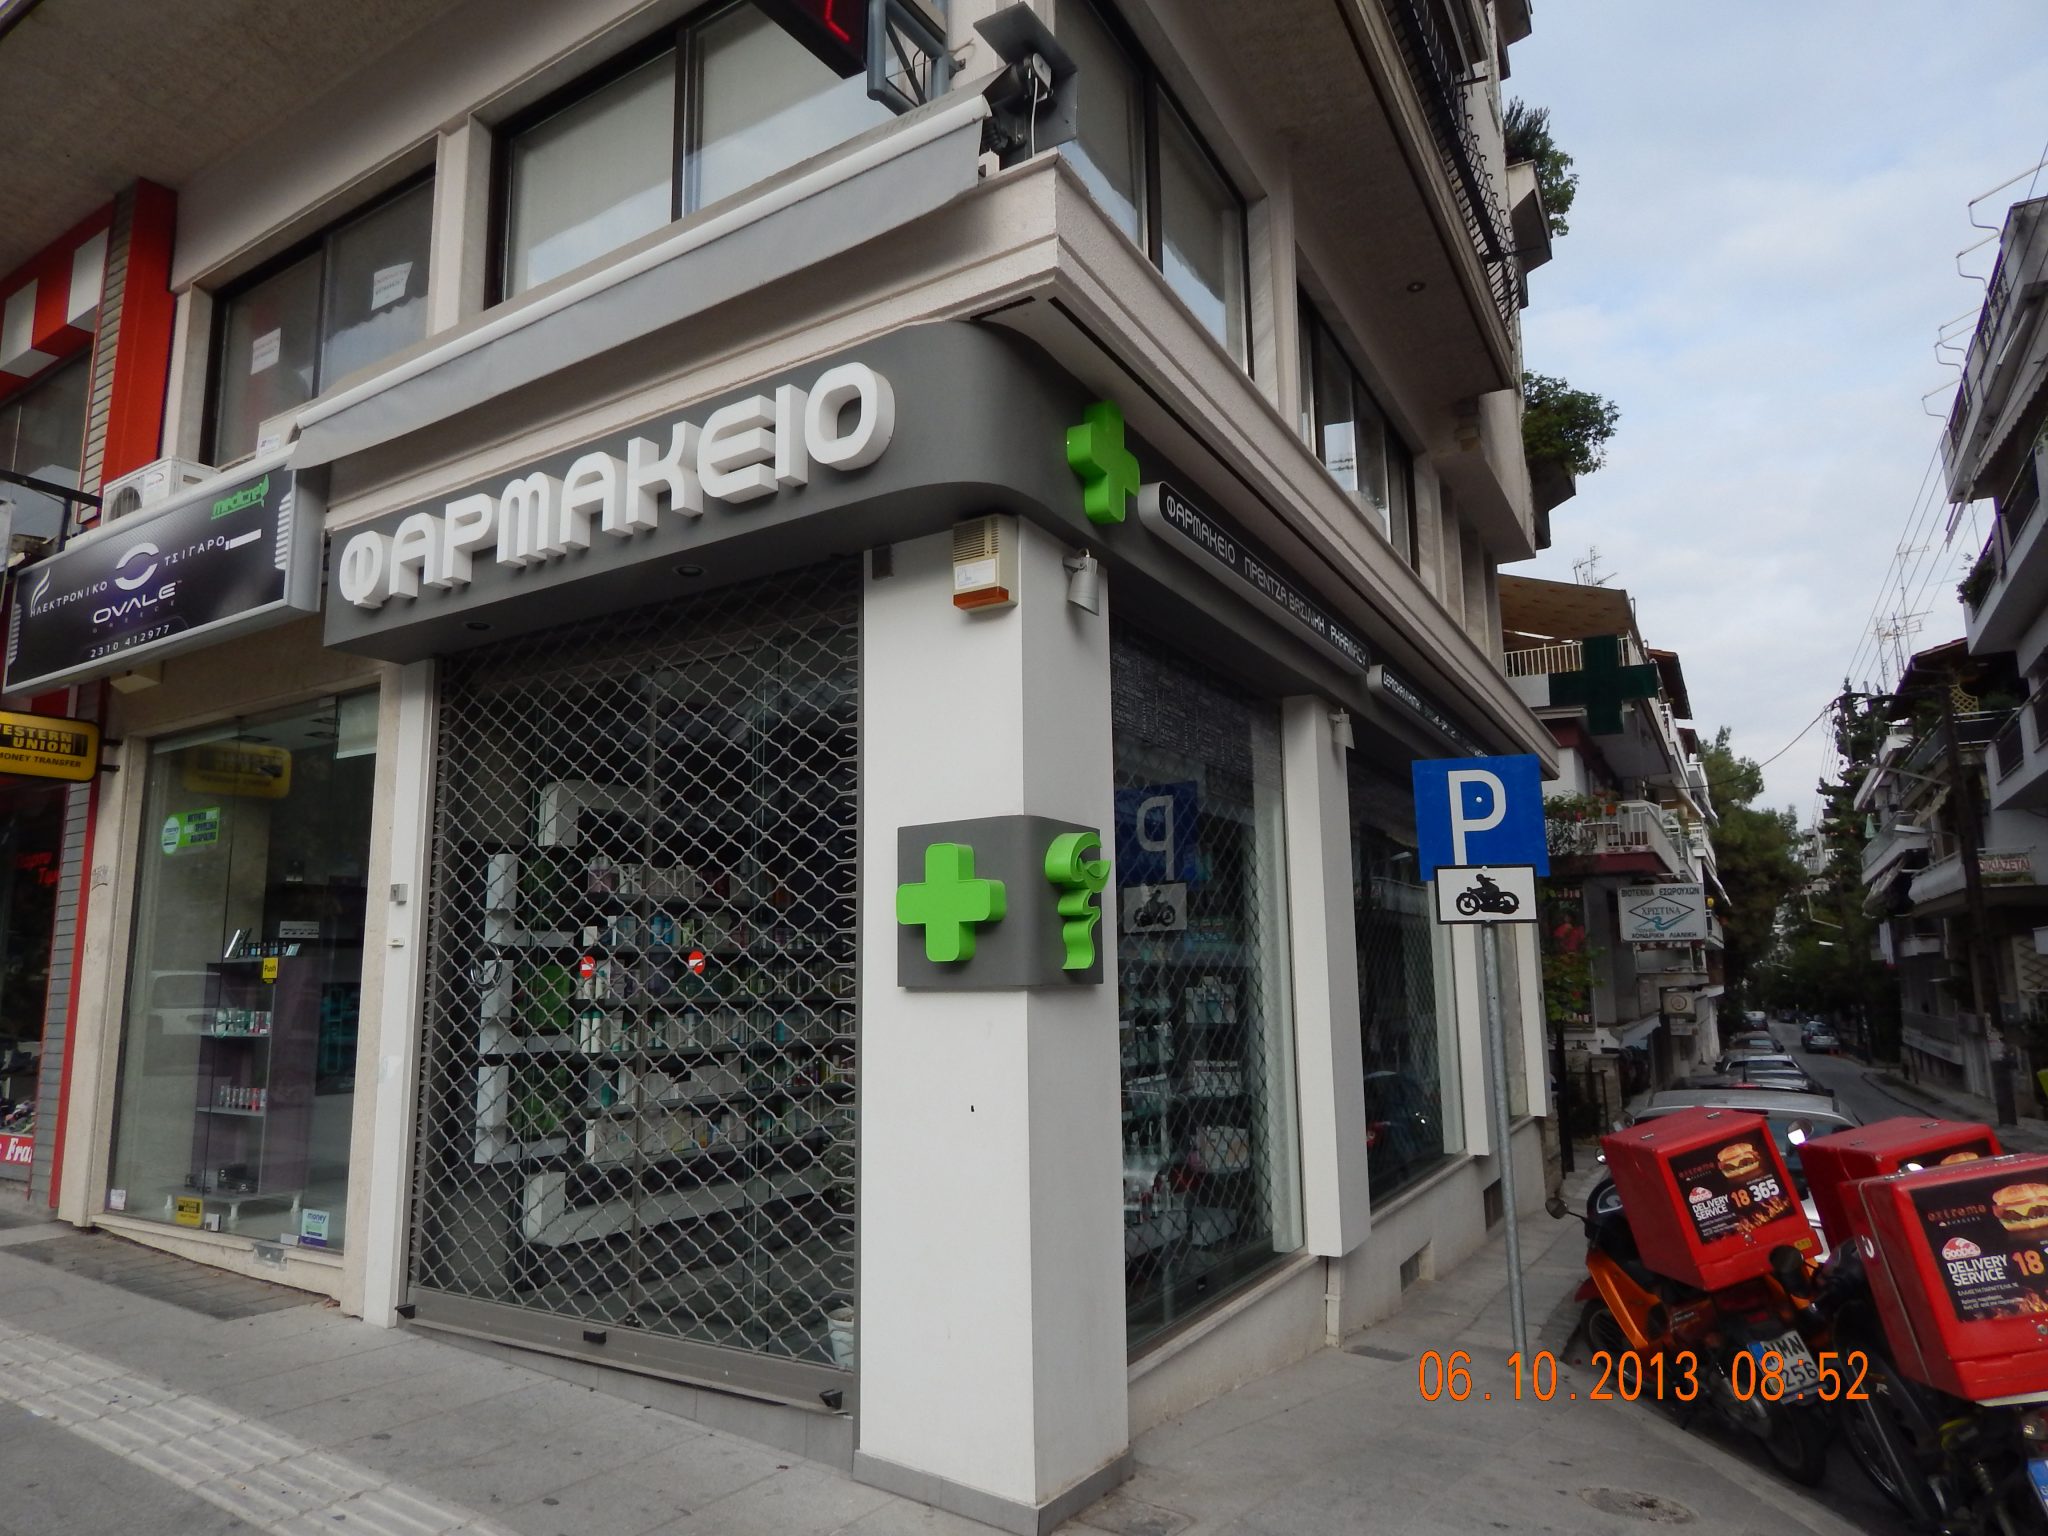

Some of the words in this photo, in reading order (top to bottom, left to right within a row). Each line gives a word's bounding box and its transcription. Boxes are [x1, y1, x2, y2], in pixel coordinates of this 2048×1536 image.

[339, 362, 895, 609] ΦΑΡΜΑΚΕΙΟ
[1166, 495, 1236, 565] ΦΑΡΜΑΚΕΙΟ
[164, 536, 226, 567] ΤΣΙΓΑΡΟ
[93, 582, 177, 624] OVALE
[90, 642, 119, 658] 2310
[125, 624, 170, 646] 412977
[0, 724, 72, 742] ESTERN
[12, 737, 72, 753] UNION
[34, 755, 82, 768] TRANSFER
[1447, 769, 1507, 866] P
[1692, 1194, 1729, 1214] DELIVERY
[1731, 1189, 1751, 1208] 18
[1749, 1178, 1780, 1202] 365
[1695, 1204, 1729, 1221] SERVICE
[1947, 1254, 2009, 1275] DELIVERY
[1952, 1267, 2007, 1287] SERVICE
[2012, 1249, 2046, 1277] 18
